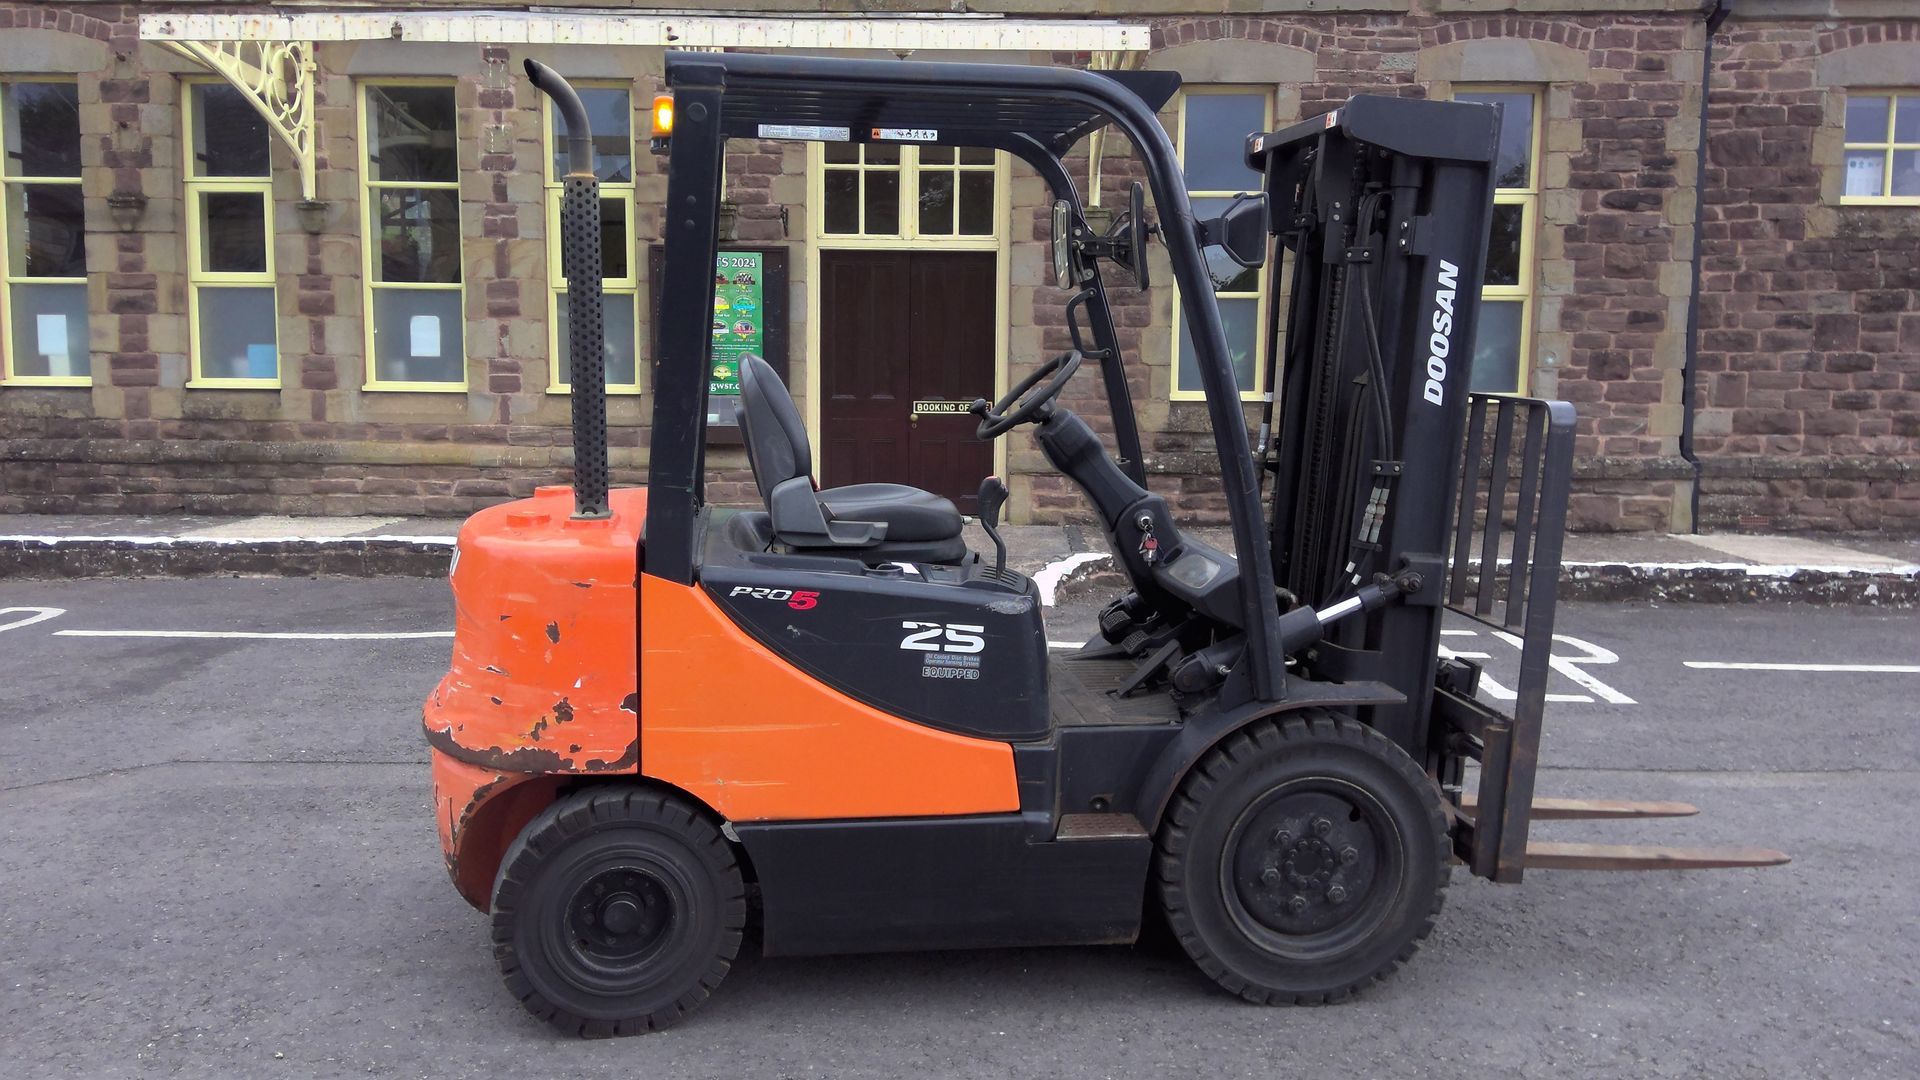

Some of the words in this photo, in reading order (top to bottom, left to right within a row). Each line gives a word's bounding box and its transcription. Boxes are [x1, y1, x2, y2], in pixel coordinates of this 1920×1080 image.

[732, 258, 756, 268] 2024
[1423, 259, 1459, 407] DOOSAN
[917, 403, 956, 412] BOOKING
[900, 621, 985, 653] 25
[922, 667, 980, 679] EQUIPPED
